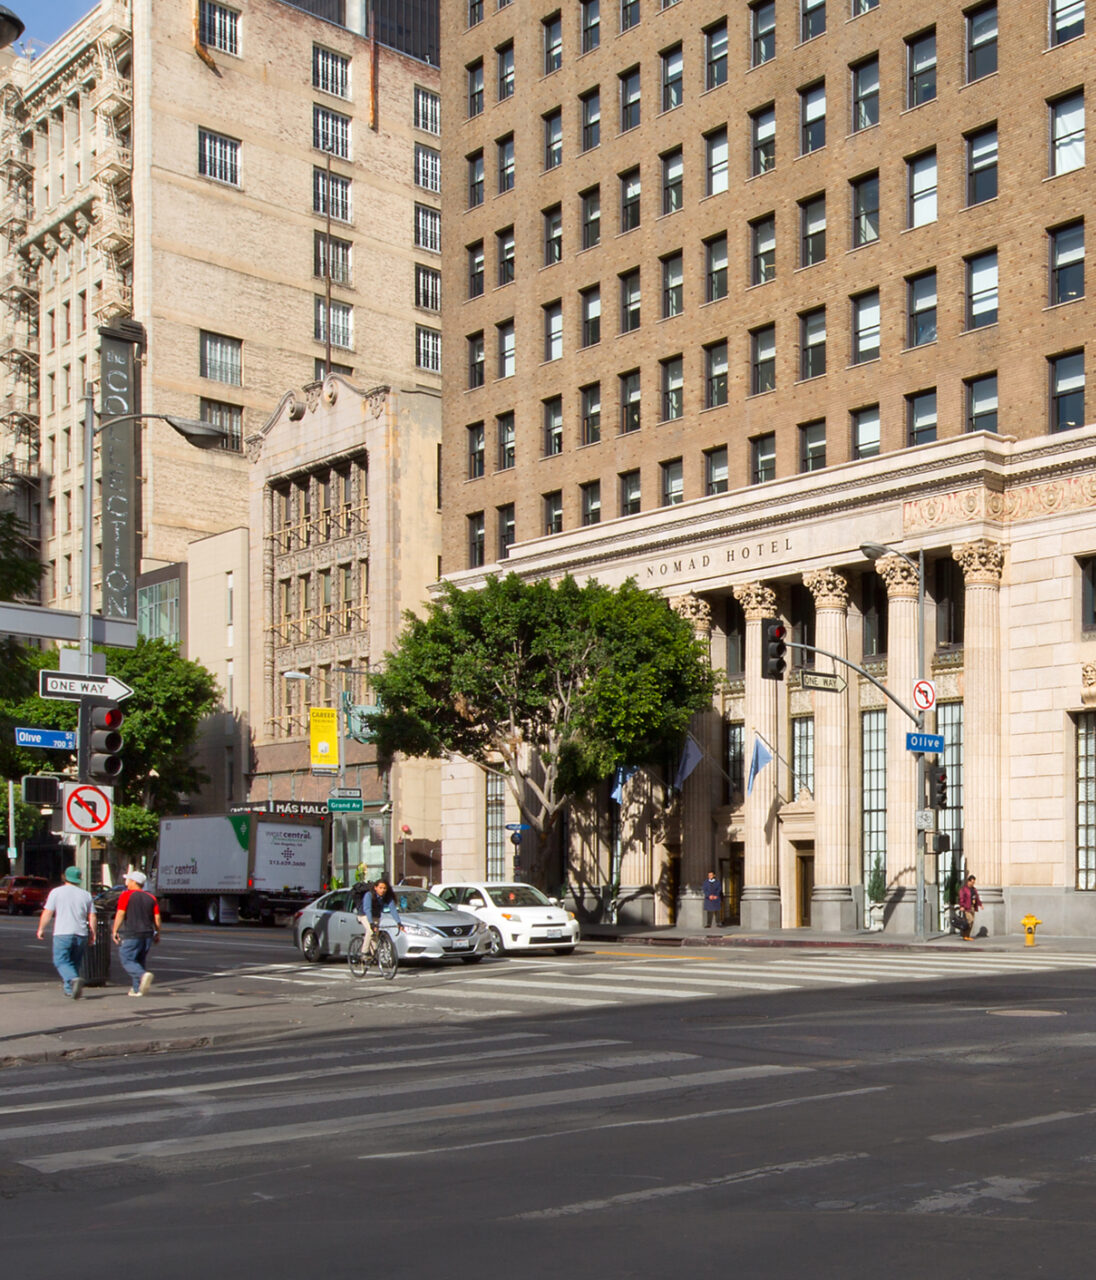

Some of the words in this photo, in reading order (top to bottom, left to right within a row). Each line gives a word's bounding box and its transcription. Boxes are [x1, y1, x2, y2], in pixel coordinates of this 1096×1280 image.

[647, 554, 710, 578] NOMAD
[726, 538, 793, 562] HOTEL
[50, 680, 76, 691] ONE
[80, 683, 105, 693] WAY
[805, 675, 819, 686] ONE
[823, 679, 837, 687] WAY
[19, 731, 42, 742] Olive
[911, 736, 940, 748] Olive
[53, 740, 66, 748] 700
[276, 803, 299, 813] MÁS
[300, 806, 328, 814] MALO
